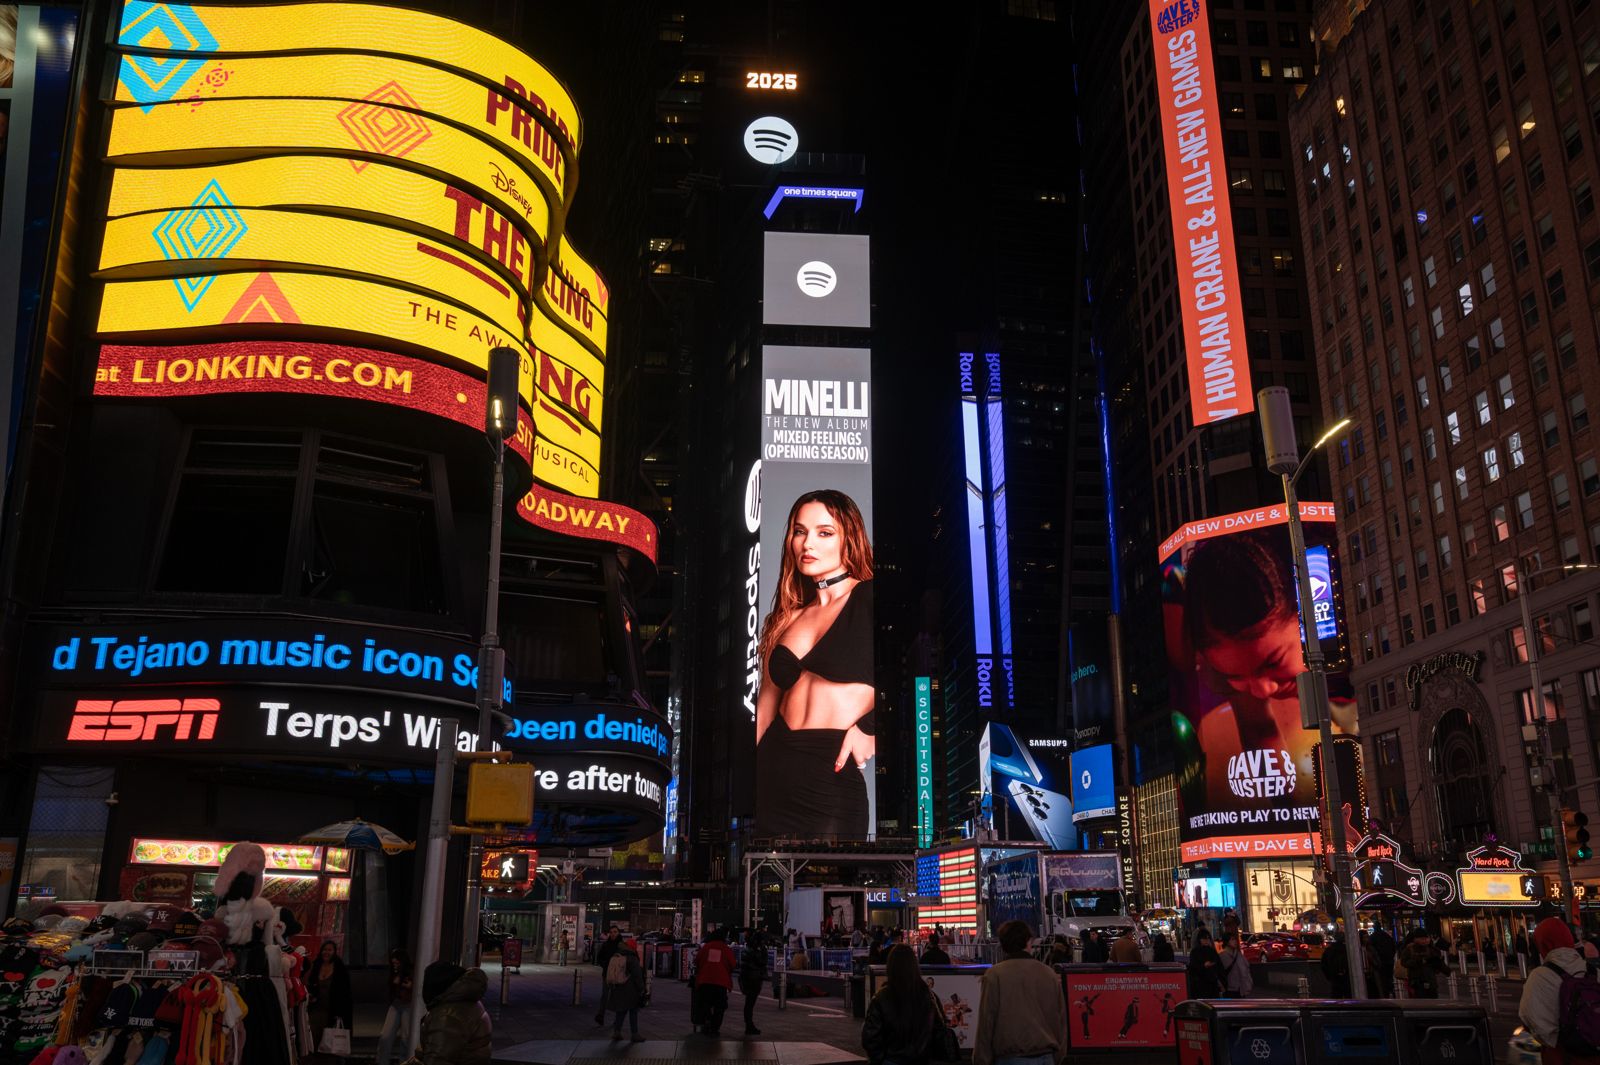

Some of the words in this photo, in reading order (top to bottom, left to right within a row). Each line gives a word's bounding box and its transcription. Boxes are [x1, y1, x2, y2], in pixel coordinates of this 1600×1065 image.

[746, 72, 797, 90] 2025
[1167, 29, 1202, 108] GAMES
[1176, 108, 1214, 206] ALL-NEW
[784, 186, 801, 196] one
[803, 187, 826, 197] times
[827, 188, 857, 200] square
[444, 184, 525, 281] THE
[1187, 206, 1217, 231] &
[1189, 230, 1226, 312] CRANE
[409, 302, 457, 331] THE
[1199, 311, 1237, 404] HUMAN
[96, 366, 121, 382] at
[132, 355, 413, 394] LIONKING.COM
[765, 379, 869, 418] MINELLI
[766, 416, 788, 428] THE
[795, 417, 821, 429] NEW
[827, 418, 868, 431] ALBUM
[773, 430, 809, 444] MIXED
[811, 431, 862, 445] FEELINGS
[764, 444, 820, 459] (OPENING
[820, 445, 869, 463] SEASON)
[520, 492, 630, 534] OADWAY
[1224, 511, 1265, 529] DAVE
[1269, 510, 1281, 519] &
[1314, 611, 1331, 623] ELL
[53, 638, 80, 670] d
[91, 636, 210, 677] Tejano
[219, 634, 352, 670] music
[363, 639, 444, 682] icon
[67, 699, 221, 740] ESPN
[259, 701, 392, 747] Terps'
[584, 714, 658, 749] denied
[1029, 739, 1068, 747] SAMSUNG
[567, 766, 632, 793] after
[1227, 749, 1281, 780] DAVE
[1282, 750, 1297, 776] &
[1228, 774, 1297, 799] BUSTER'S
[1119, 795, 1131, 845] SQUARE
[1241, 809, 1270, 823] PLAY
[1272, 808, 1290, 821] TO
[1254, 840, 1299, 851] DAVE
[1303, 838, 1315, 849] &
[1123, 857, 1134, 896] TIMES
[1474, 857, 1492, 867] Hard
[1493, 857, 1510, 867] Rock
